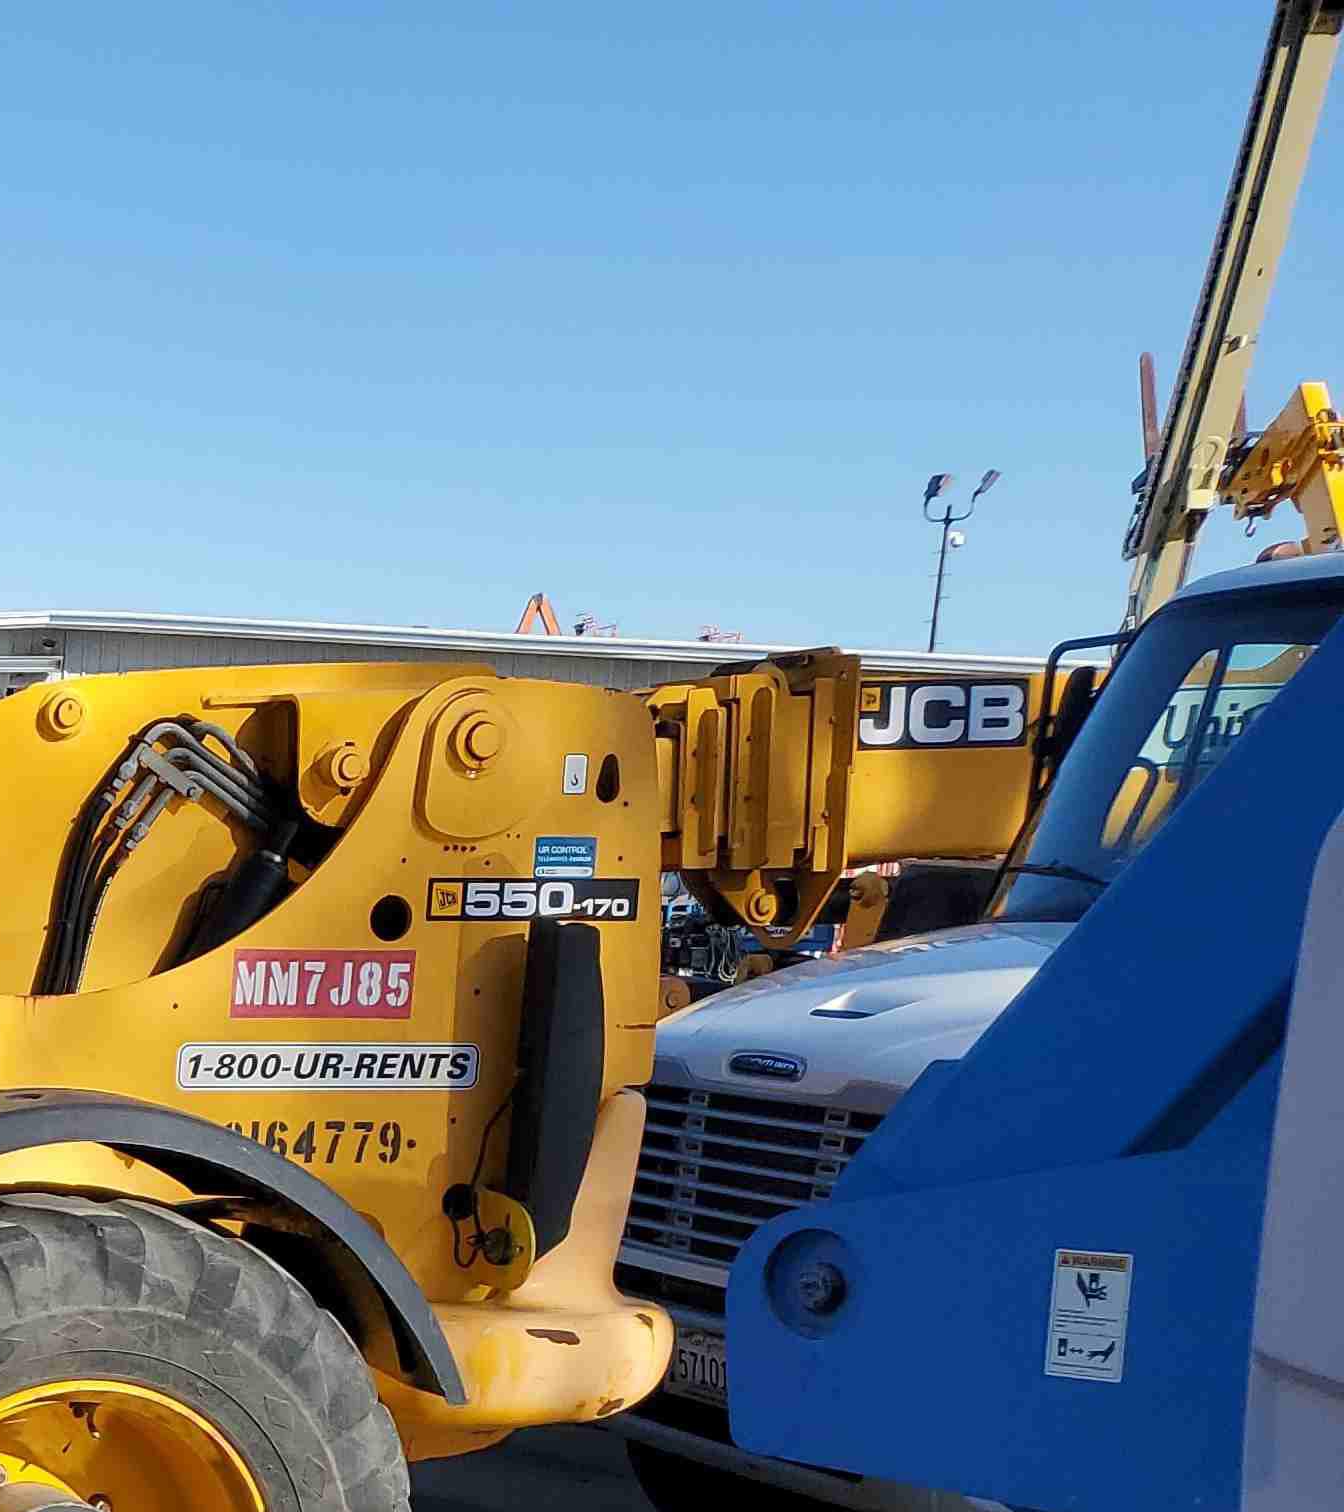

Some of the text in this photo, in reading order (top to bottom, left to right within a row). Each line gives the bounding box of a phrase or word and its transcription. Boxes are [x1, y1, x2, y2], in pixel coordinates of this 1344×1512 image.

[859, 685, 1025, 745] JCB
[233, 960, 411, 1007] MM7J85
[187, 1052, 471, 1080] 1-800-UR-RENTS
[669, 1348, 726, 1391] 57101
